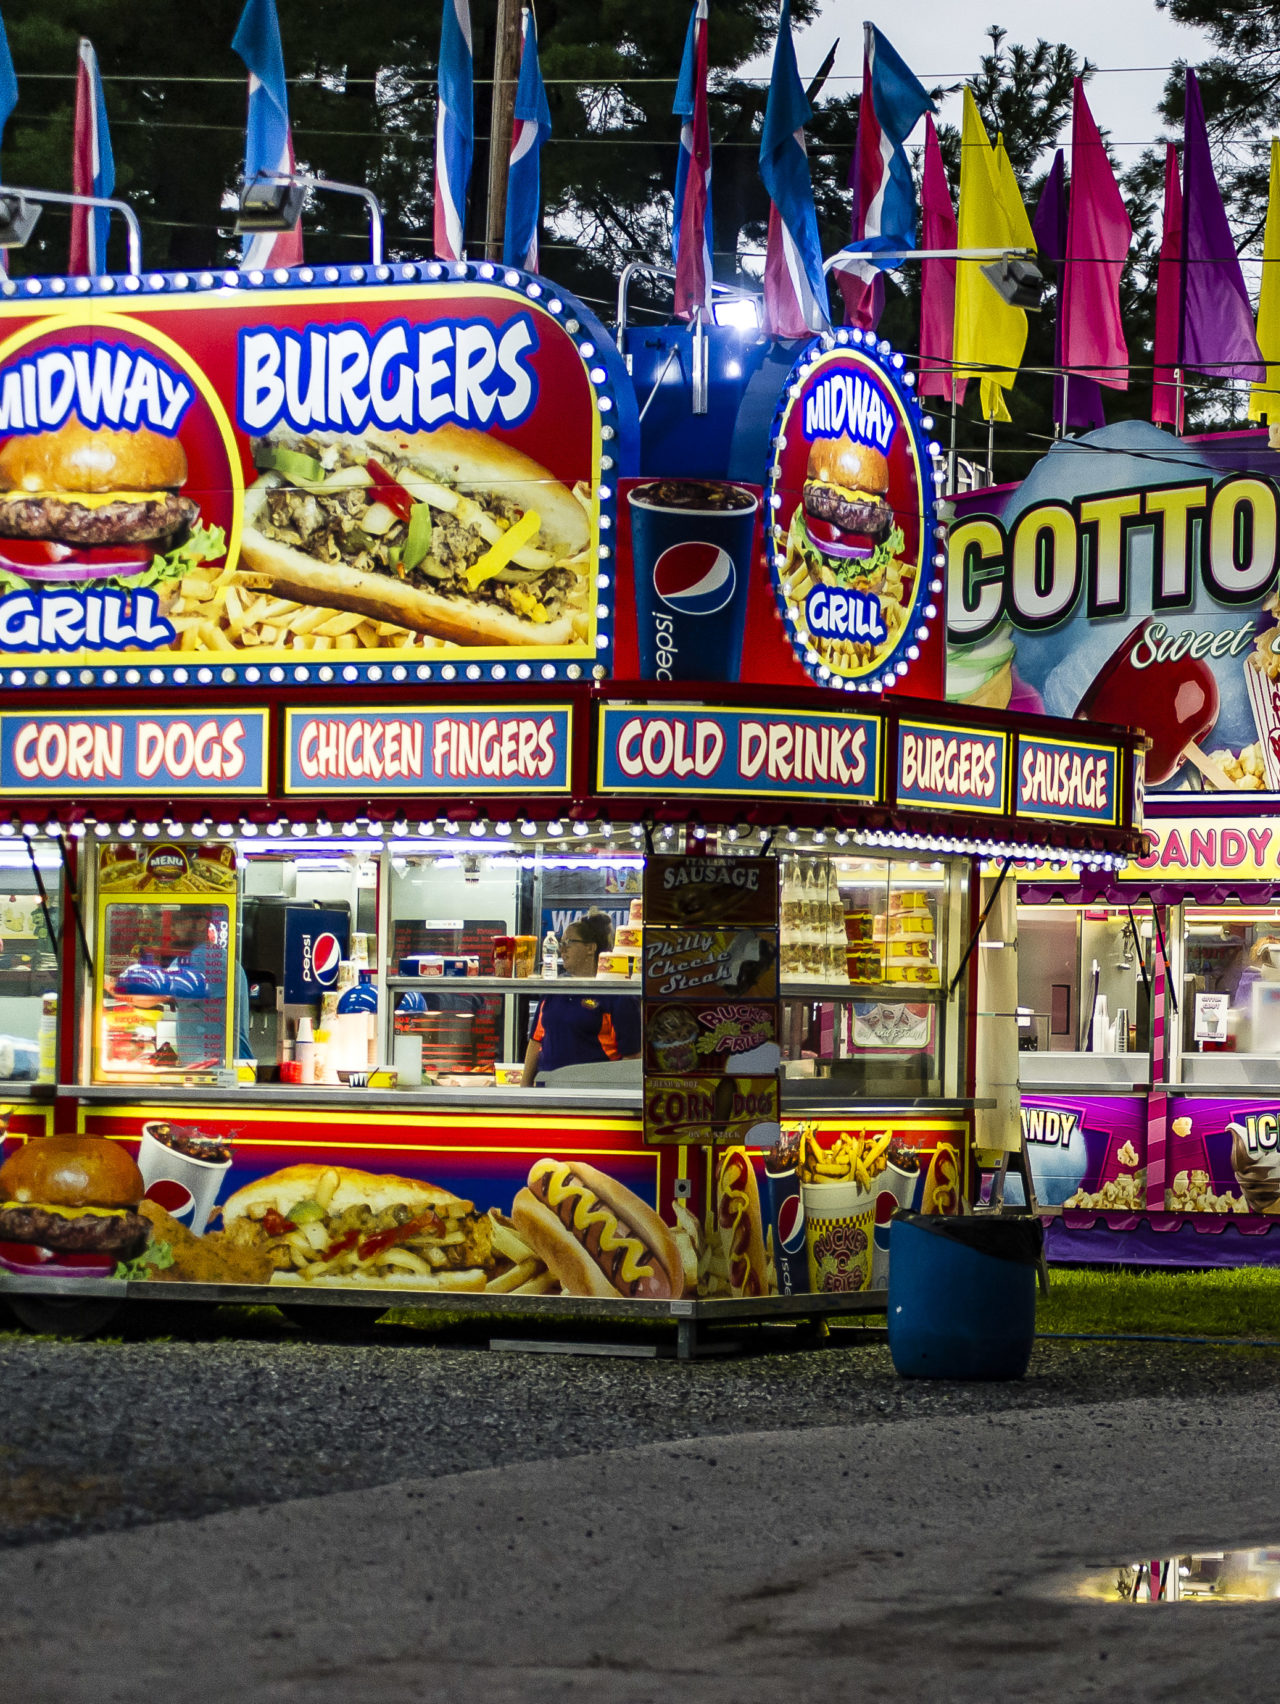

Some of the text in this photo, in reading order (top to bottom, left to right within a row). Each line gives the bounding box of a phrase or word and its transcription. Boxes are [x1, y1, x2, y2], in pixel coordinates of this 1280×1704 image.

[0, 346, 191, 430] MIDWAY
[242, 319, 534, 430] BURGERS
[805, 373, 894, 449] MIDWAY
[0, 595, 171, 646] GRILL
[808, 591, 884, 638] GRILL
[1130, 620, 1256, 669] Sweet
[14, 718, 246, 780] CORN DOGS
[299, 716, 556, 781] CHICKEN FINGERS
[616, 717, 868, 785] COLD DRINKS
[901, 732, 997, 799] BURGERS
[1020, 747, 1110, 810] SAUSAGE
[150, 855, 184, 867] MENU
[1136, 828, 1273, 868] CANDY
[663, 867, 761, 892] SAUSAGE
[302, 934, 313, 982] pepsi
[646, 934, 714, 960] Philly
[648, 951, 731, 978] Cheese
[659, 965, 734, 994] Steak
[650, 1090, 774, 1126] CORN DOGS
[1020, 1107, 1079, 1150] ANDY
[780, 1256, 793, 1296] epsi
[822, 1267, 864, 1292] FRIES
